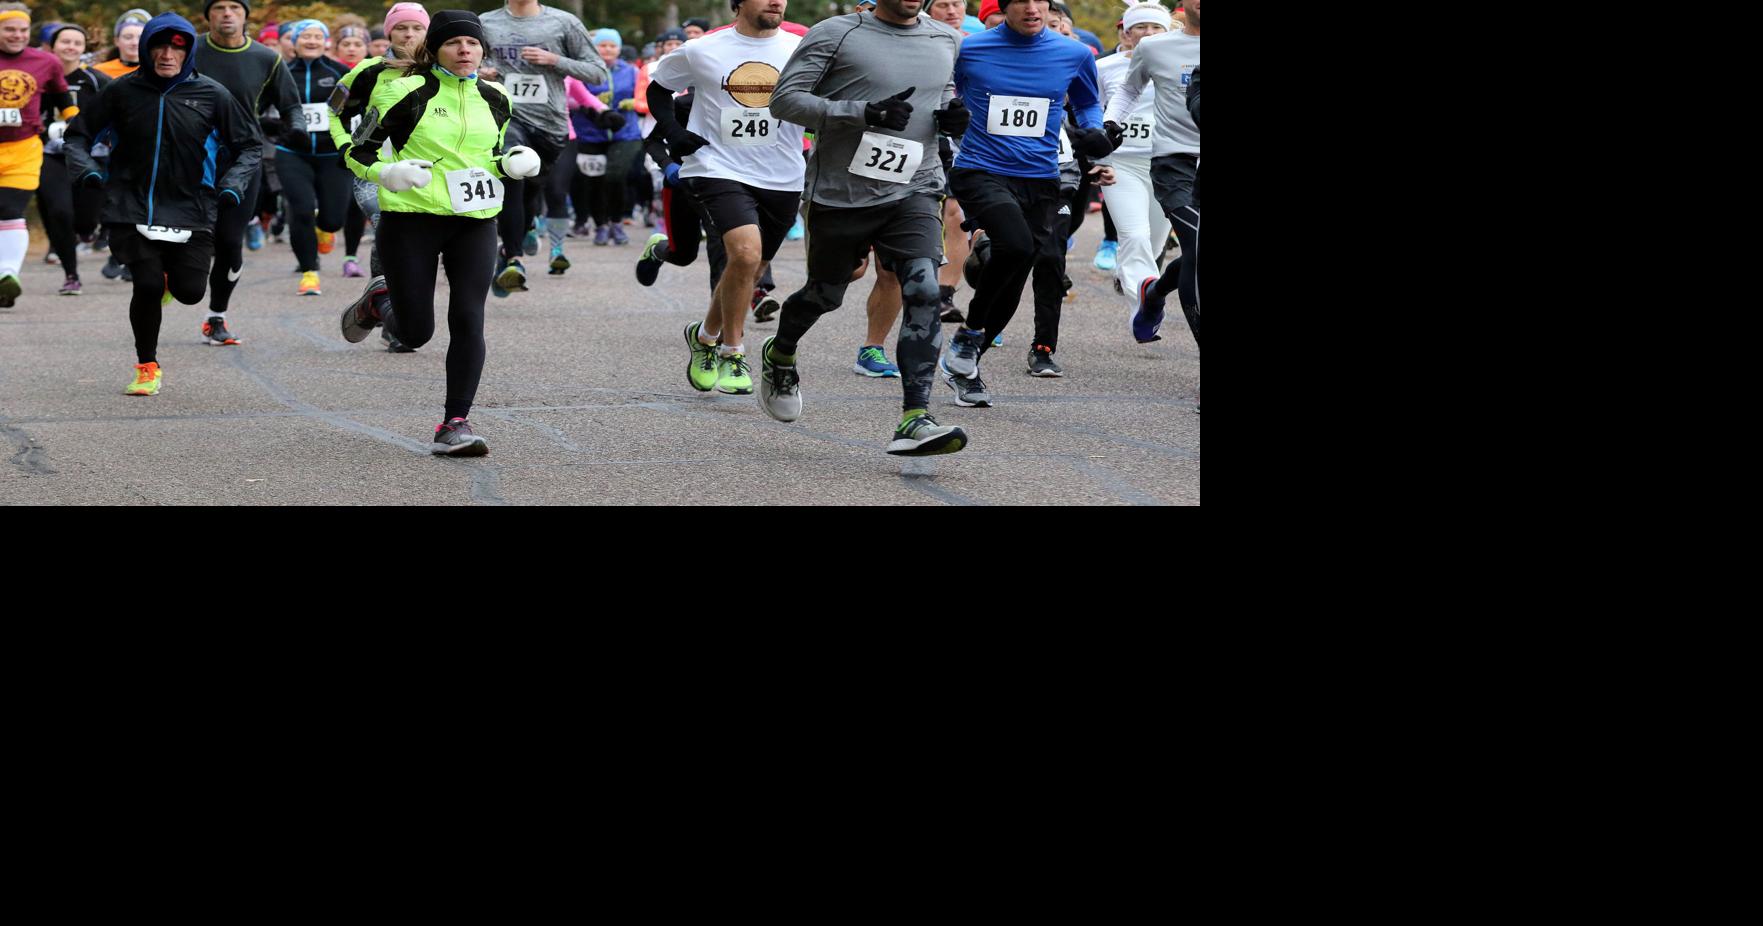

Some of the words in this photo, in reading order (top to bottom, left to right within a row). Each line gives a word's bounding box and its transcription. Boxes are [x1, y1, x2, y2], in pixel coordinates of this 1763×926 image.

[513, 83, 540, 97] 177
[306, 112, 322, 125] 93
[1000, 108, 1038, 128] 180
[731, 119, 769, 138] 248
[1120, 122, 1151, 139] 255
[865, 147, 908, 173] 321
[460, 178, 496, 202] 341
